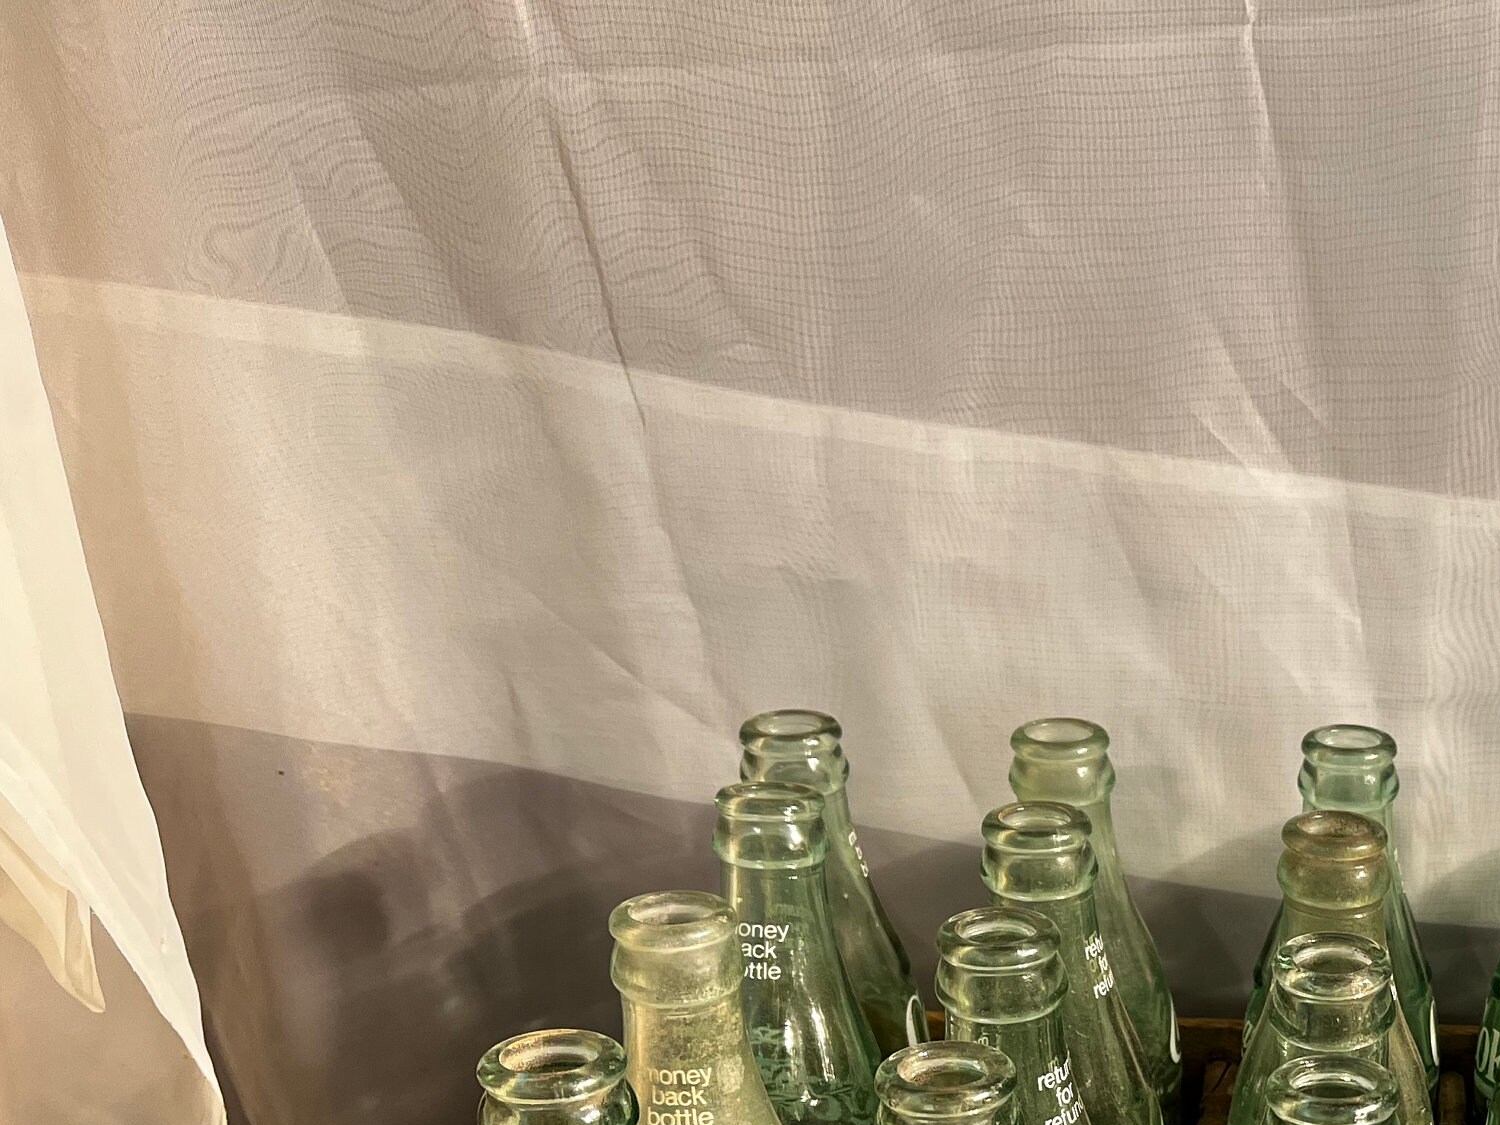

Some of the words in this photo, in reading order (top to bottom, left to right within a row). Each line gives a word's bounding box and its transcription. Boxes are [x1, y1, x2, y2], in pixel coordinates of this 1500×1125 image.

[738, 922, 789, 943] oney
[742, 941, 777, 959] ack
[744, 961, 781, 981] ttle
[652, 1085, 708, 1107] back
